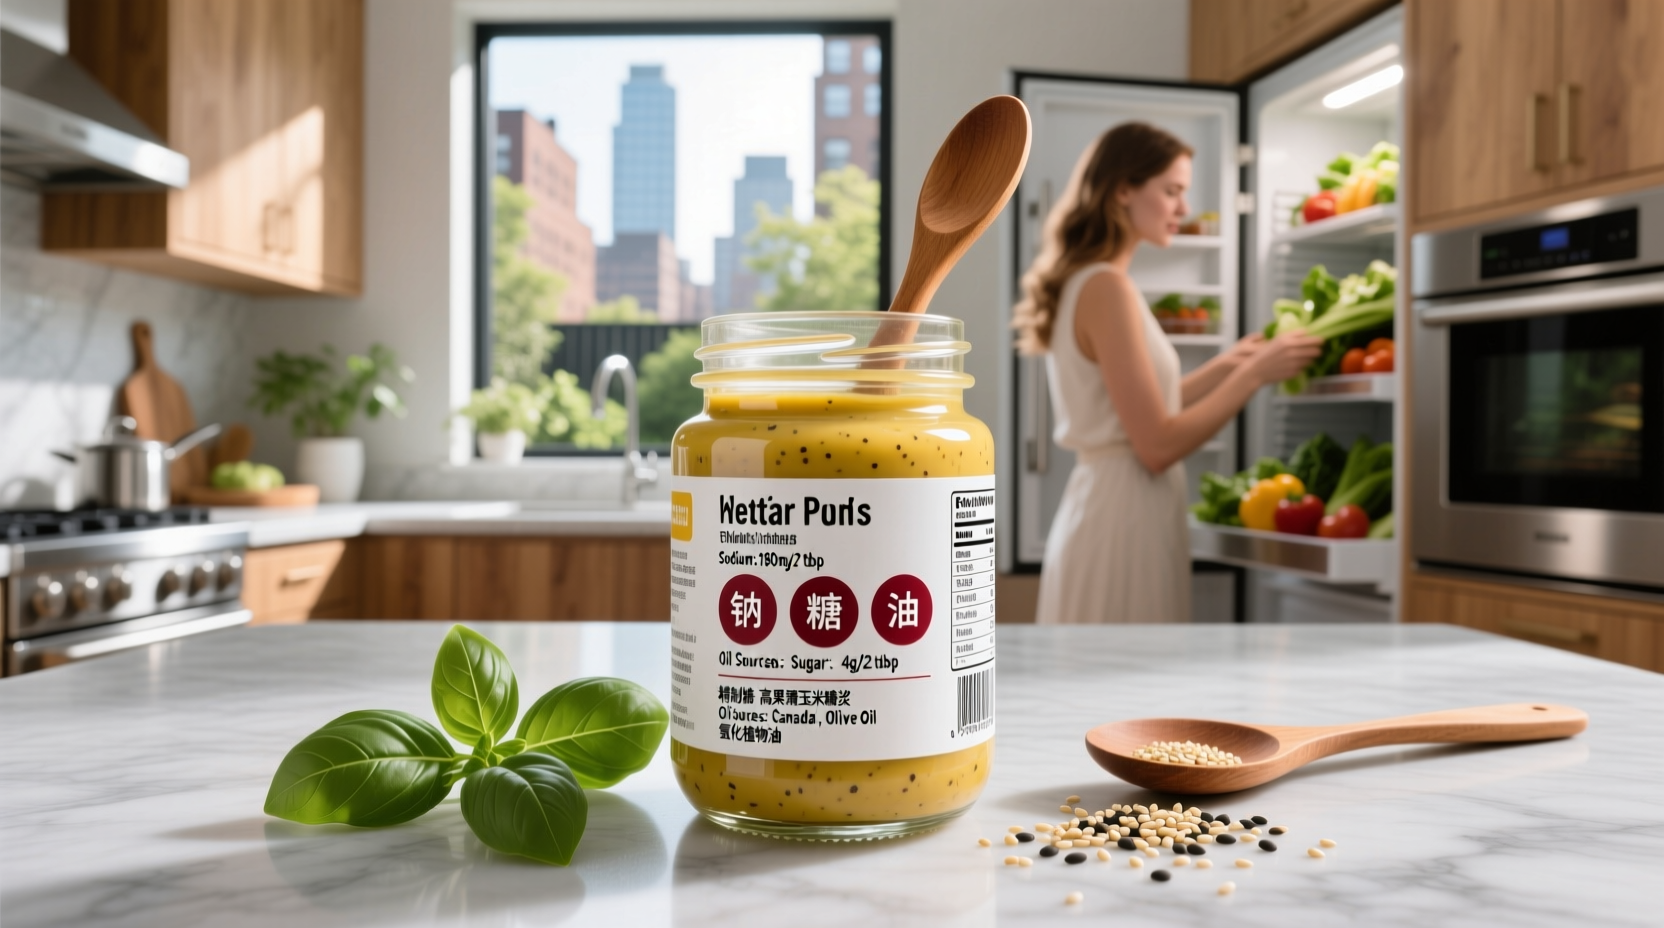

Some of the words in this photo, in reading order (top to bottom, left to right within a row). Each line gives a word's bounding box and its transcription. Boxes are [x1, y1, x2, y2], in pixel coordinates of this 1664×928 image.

[730, 590, 762, 629] 钠
[806, 592, 842, 631] 糖
[887, 590, 919, 629] 油
